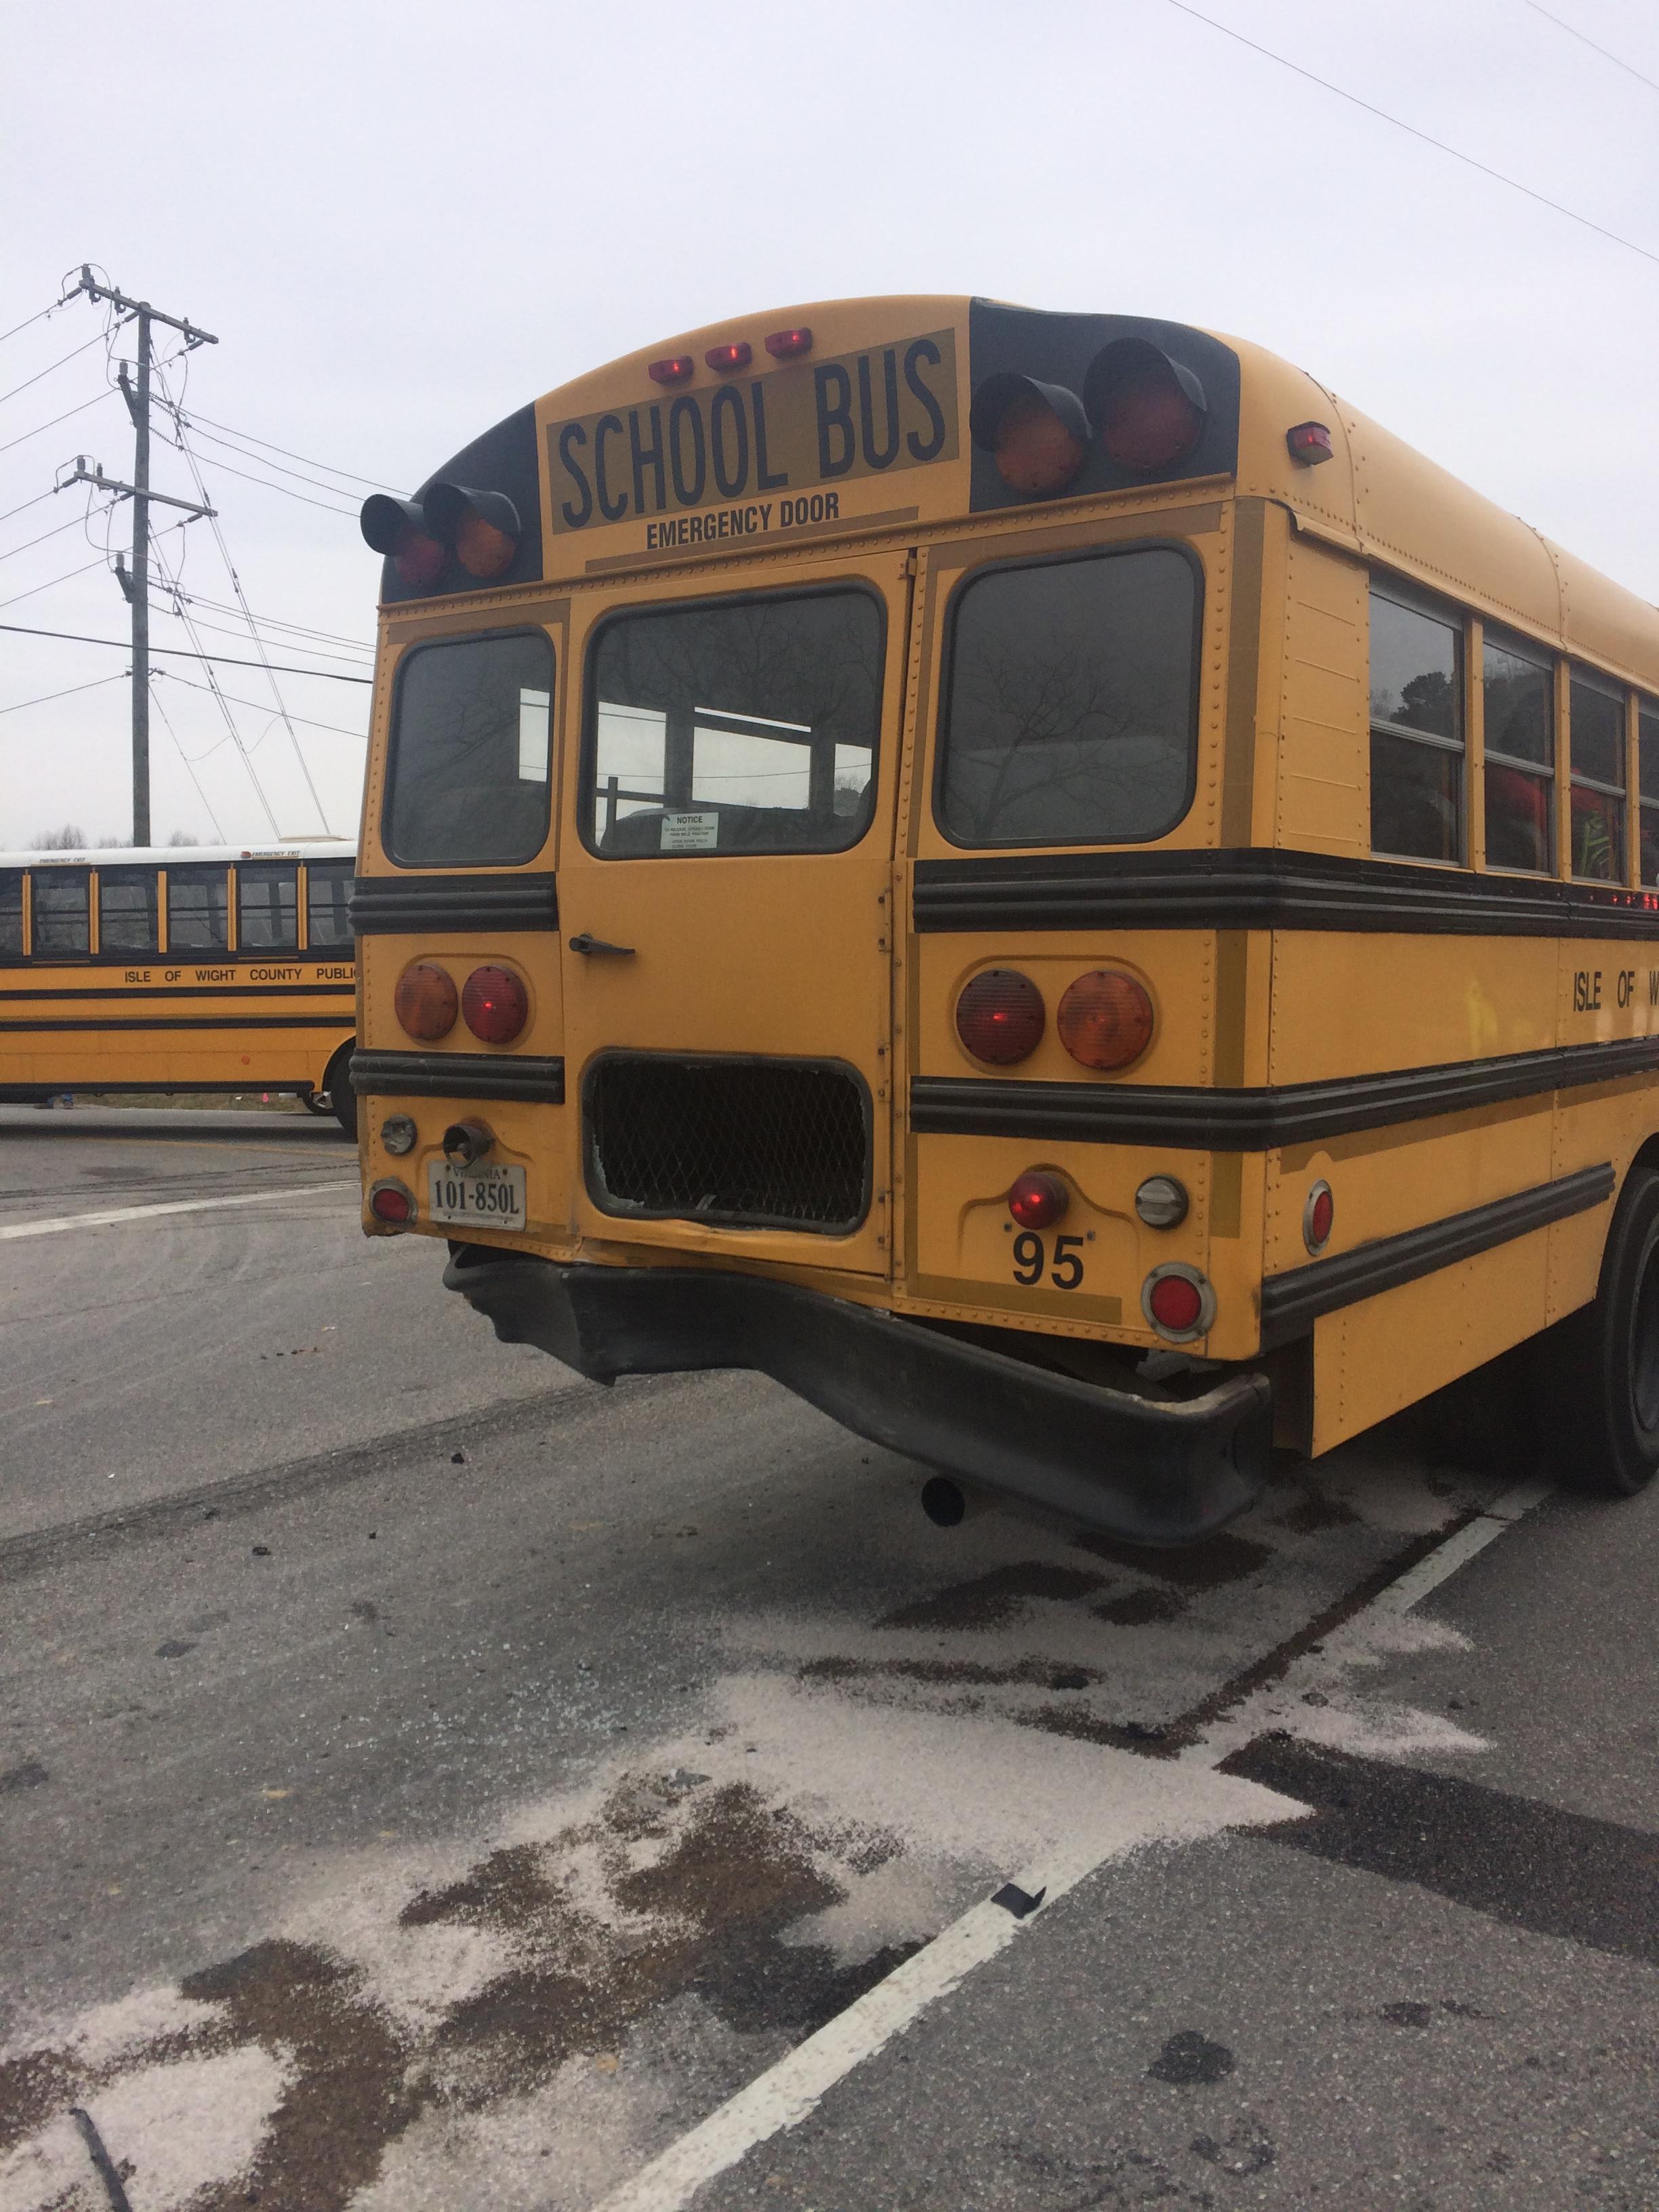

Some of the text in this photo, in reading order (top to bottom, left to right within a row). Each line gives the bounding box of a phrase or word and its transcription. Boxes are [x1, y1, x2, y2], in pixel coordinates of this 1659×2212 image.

[559, 338, 946, 529] SCHOOL BUS
[647, 492, 840, 550] EMERGENCY DOOR
[676, 816, 703, 825] NOTICE
[125, 967, 356, 983] ISLE OF WIGHT COUNTY PUBLI
[1573, 971, 1602, 1012] ISLE
[1617, 970, 1635, 1008] OF
[434, 1180, 520, 1214] 101-850L
[1012, 1231, 1084, 1290] 95
